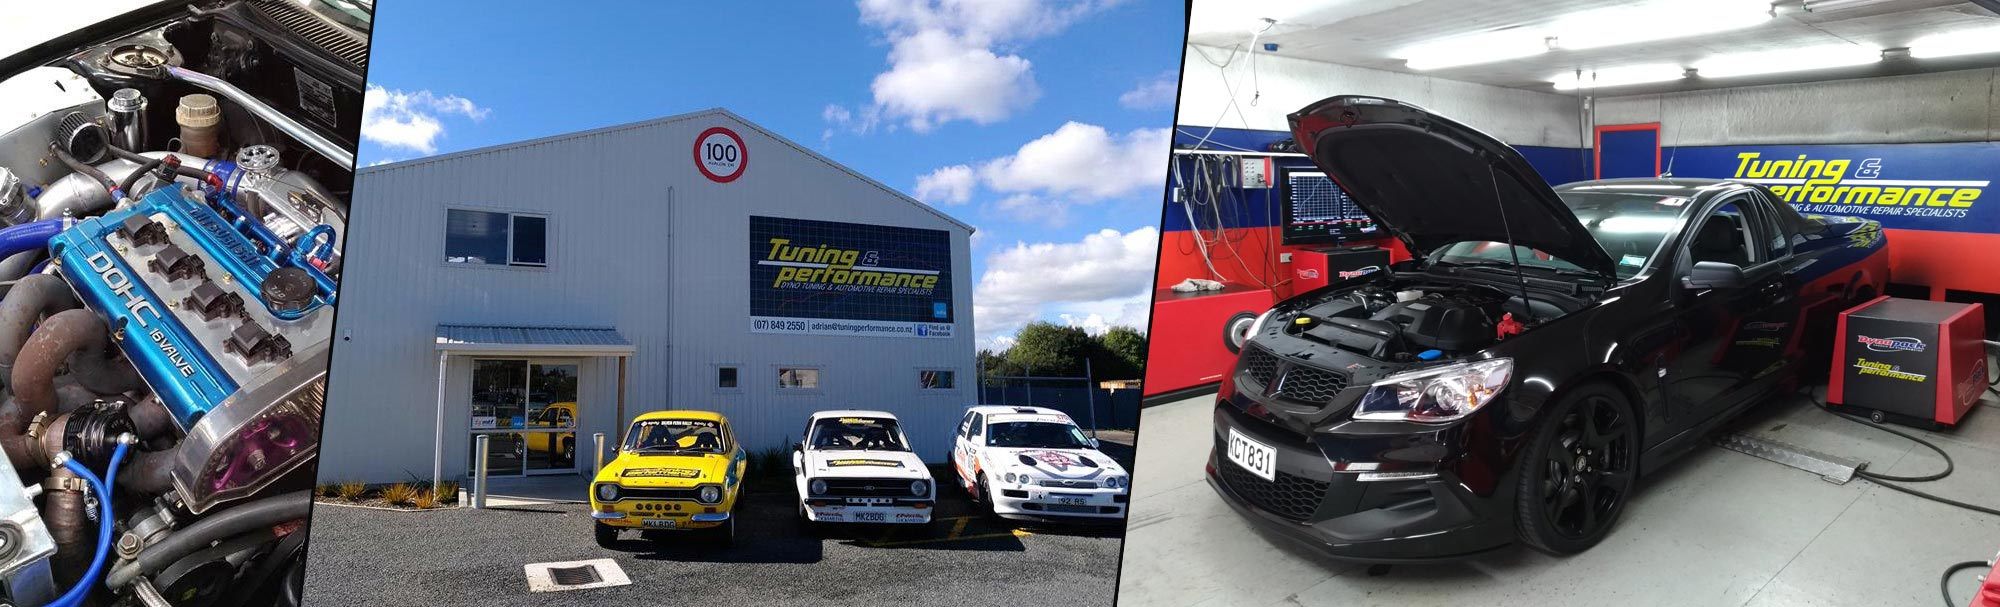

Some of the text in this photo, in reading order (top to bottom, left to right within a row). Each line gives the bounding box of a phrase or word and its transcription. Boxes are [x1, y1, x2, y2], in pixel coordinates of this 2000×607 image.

[706, 142, 737, 162] 100
[1734, 152, 1882, 184] Tuning &
[1767, 179, 1982, 207] erformance
[1804, 203, 1812, 212] &
[1812, 204, 1872, 214] AUTOMOTIVE
[1871, 206, 1904, 215] REPAIR
[1904, 207, 1969, 218] SPECIALISTS
[768, 238, 879, 270] Tuning &
[773, 264, 940, 289] performance
[86, 250, 162, 328] DOHC
[802, 282, 826, 290] TUNING
[827, 283, 833, 291] &
[834, 284, 875, 293] AUTOMOTIVE
[876, 286, 897, 294] REPAIR
[897, 287, 934, 296] SPECIALISTS
[754, 320, 806, 331] (07) 849 2550
[811, 323, 913, 333] adrian@tuningperformance.co.nz
[1857, 358, 1892, 370] Tuning
[1858, 368, 1926, 382] performance
[1230, 432, 1271, 475] KCT831
